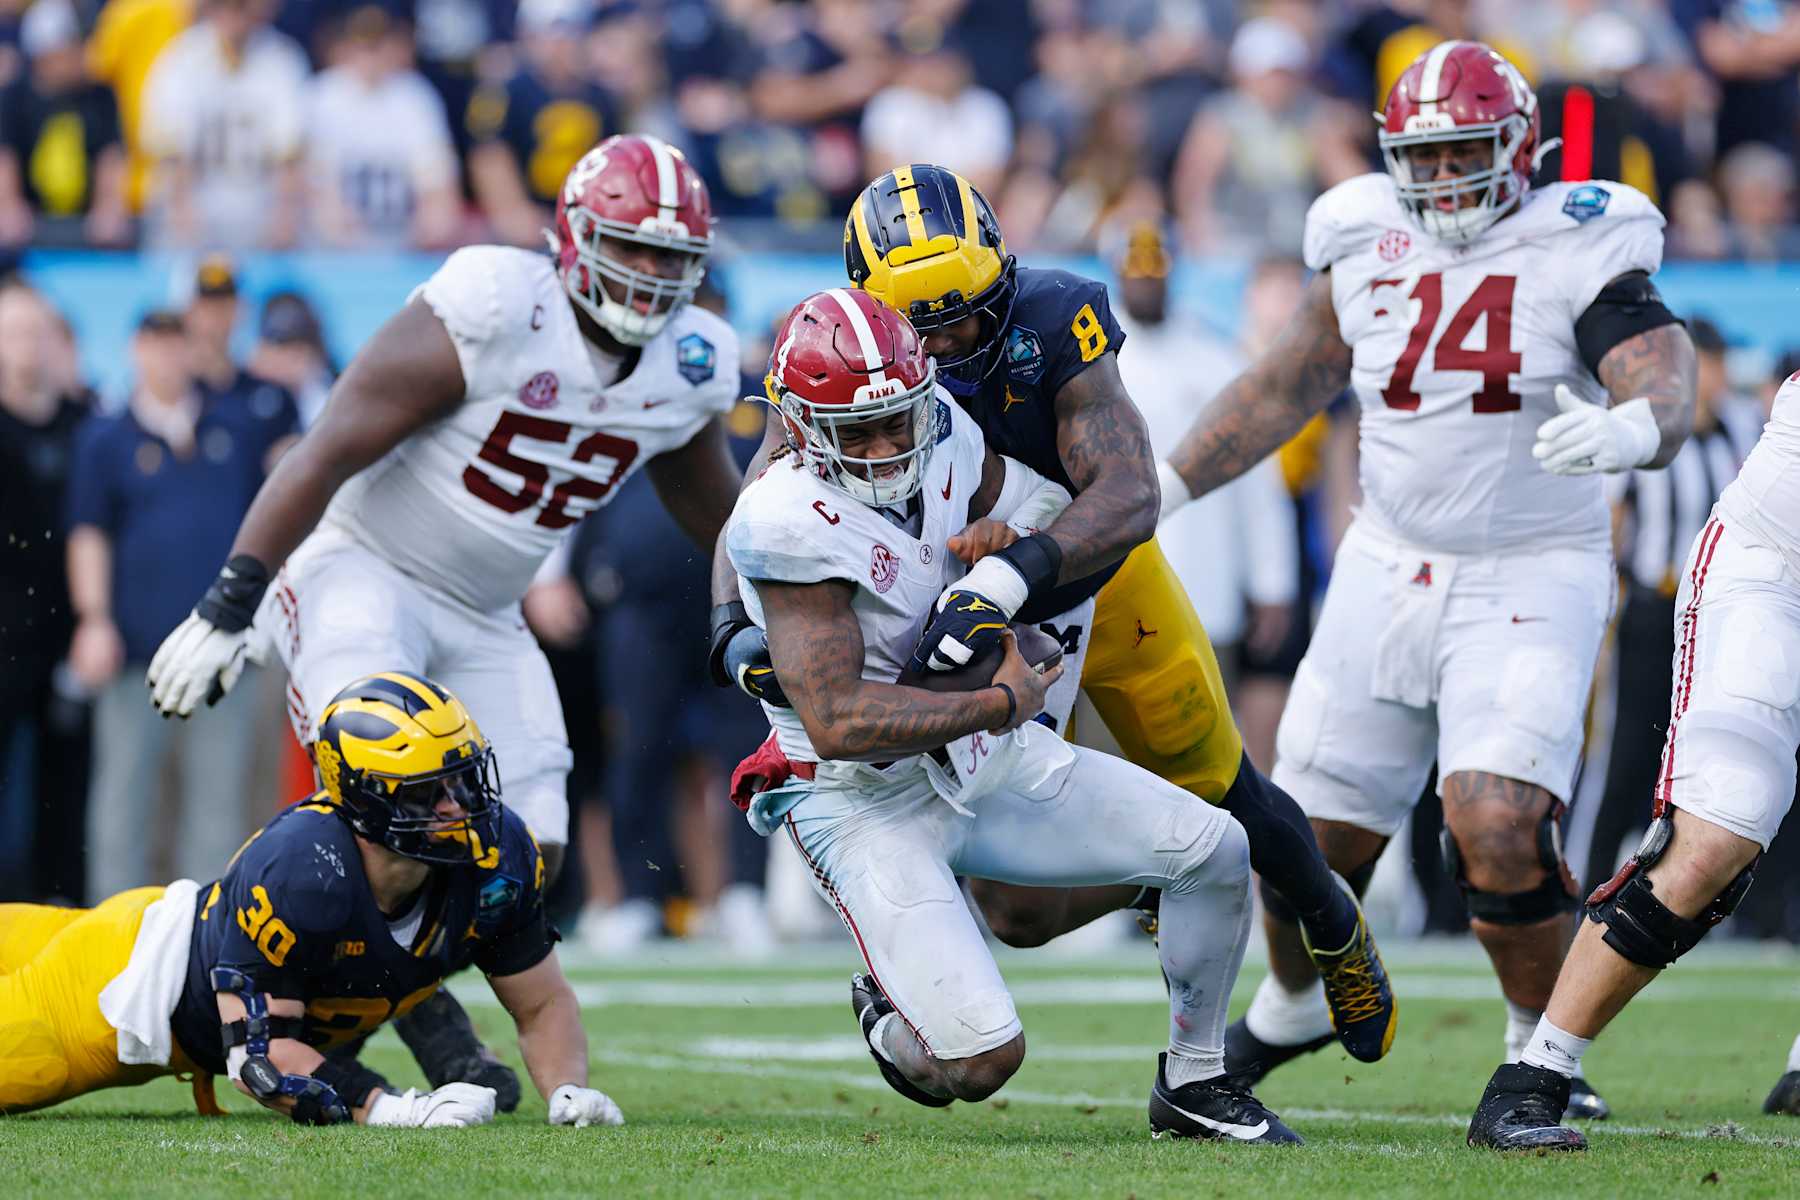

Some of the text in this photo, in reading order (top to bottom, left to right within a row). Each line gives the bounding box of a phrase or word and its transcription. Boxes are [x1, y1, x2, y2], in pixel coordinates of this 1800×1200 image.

[530, 304, 544, 332] C
[929, 299, 945, 312] M
[1071, 303, 1109, 363] 8
[1370, 272, 1522, 414] 74
[868, 386, 897, 401] BAMA
[462, 409, 641, 531] 52
[811, 499, 841, 526] C
[236, 884, 297, 968] 30
